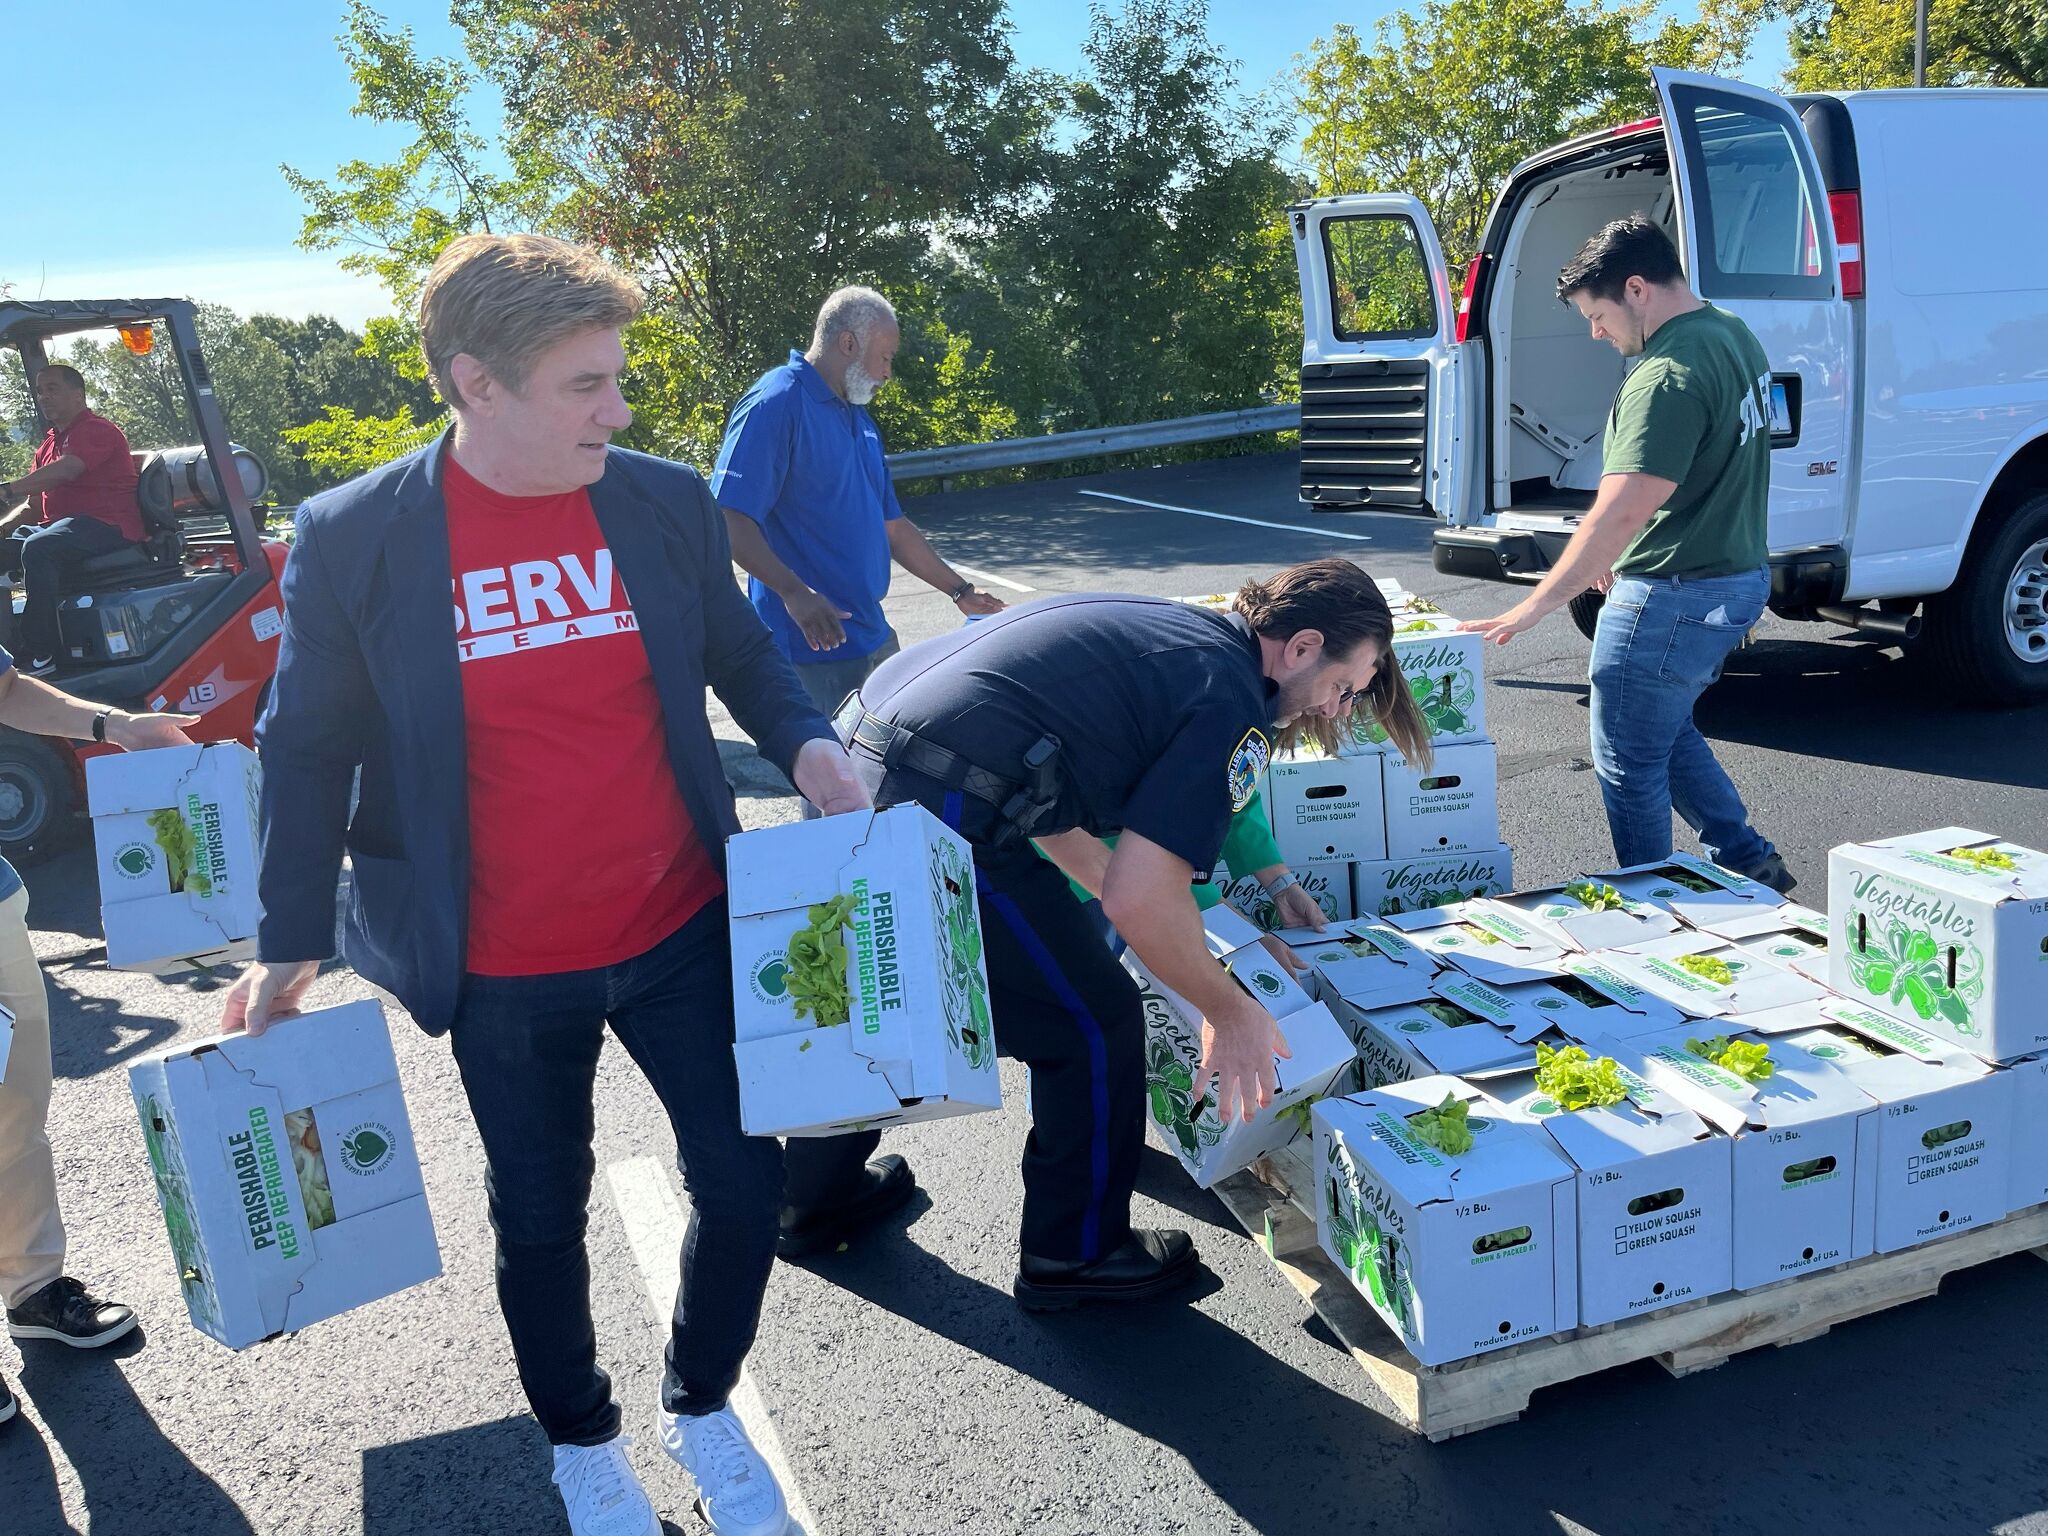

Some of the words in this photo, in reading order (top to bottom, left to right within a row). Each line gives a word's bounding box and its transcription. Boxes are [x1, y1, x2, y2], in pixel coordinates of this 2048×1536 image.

[1807, 461, 1837, 477] GMC
[452, 548, 632, 634] ERV
[459, 613, 636, 658] TEAM
[1396, 644, 1467, 672] tables
[188, 793, 204, 820] KEEP
[1306, 804, 1332, 813] YELLOW
[1333, 801, 1360, 810] SQUASH
[1420, 795, 1446, 804] YELLOW
[1447, 792, 1474, 801] SQUASH
[1420, 806, 1441, 815] GREEN
[1443, 803, 1470, 812] SQUASH
[1306, 814, 1328, 823] GREEN
[1330, 812, 1356, 820] SQUASH
[204, 803, 228, 884] PERISHABLE
[191, 823, 213, 899] REFRIGERAD
[1215, 870, 1330, 906] Vegeles
[1382, 859, 1497, 896] Vegetables
[1884, 875, 1908, 889] FARM
[1909, 883, 1937, 897] FRESH
[852, 879, 870, 917] KEEP
[1849, 870, 1979, 938] Vegetables
[2029, 902, 2042, 915] 1/2
[872, 892, 902, 1012] PERISHABLE
[855, 920, 881, 1035] REFRIGERATED
[1589, 964, 1645, 998] PERISHABLE
[1642, 964, 1701, 992] PERISHABLE
[1460, 981, 1517, 1010] PERISHABLE
[1858, 1011, 1935, 1044] PERISHABLE
[1349, 1019, 1416, 1081] Vegetabl
[1615, 1067, 1660, 1095] ISHABLE
[1651, 1051, 1721, 1088] PERISHABLE
[1888, 1107, 1901, 1118] 1/2
[1903, 1104, 1918, 1114] Bu.
[1366, 1121, 1424, 1165] PERISHABLE
[1768, 1133, 1782, 1145] 1/2
[1785, 1131, 1801, 1141] Bu.
[1920, 1149, 1952, 1165] YELLOW
[1953, 1139, 1985, 1156] SQUASH
[249, 1106, 291, 1219] REFRIGERATED
[1419, 1150, 1445, 1168] KEEP
[1920, 1165, 1946, 1180] GREEN
[1947, 1155, 1979, 1173] SQUASH
[229, 1130, 277, 1251] PERISHABLE
[1324, 1133, 1408, 1235] Vegetables
[1589, 1174, 1603, 1187] 1/2
[1606, 1172, 1622, 1182] Bu.
[1455, 1206, 1470, 1219] 1/2
[1473, 1203, 1491, 1214] Bu.
[1628, 1217, 1663, 1235] YELLOW
[1665, 1207, 1702, 1225] SQUASH
[1628, 1235, 1658, 1251] GREEN
[1659, 1224, 1696, 1243] SQUASH
[1916, 1224, 1946, 1237] Produce
[1948, 1219, 1956, 1228] of
[1957, 1215, 1972, 1225] USA
[274, 1221, 301, 1261] KEEP
[1471, 1255, 1495, 1266] GROWN
[1503, 1245, 1528, 1258] PACKED
[1529, 1243, 1538, 1251] BY
[1780, 1259, 1812, 1272] Produce
[1814, 1253, 1822, 1263] of
[1824, 1249, 1840, 1260] USA
[1629, 1295, 1662, 1309] Produce
[1664, 1291, 1673, 1300] of
[1675, 1286, 1692, 1297] USA
[1474, 1335, 1509, 1349] Produce
[1511, 1329, 1520, 1339] of
[1522, 1325, 1540, 1336] USA
